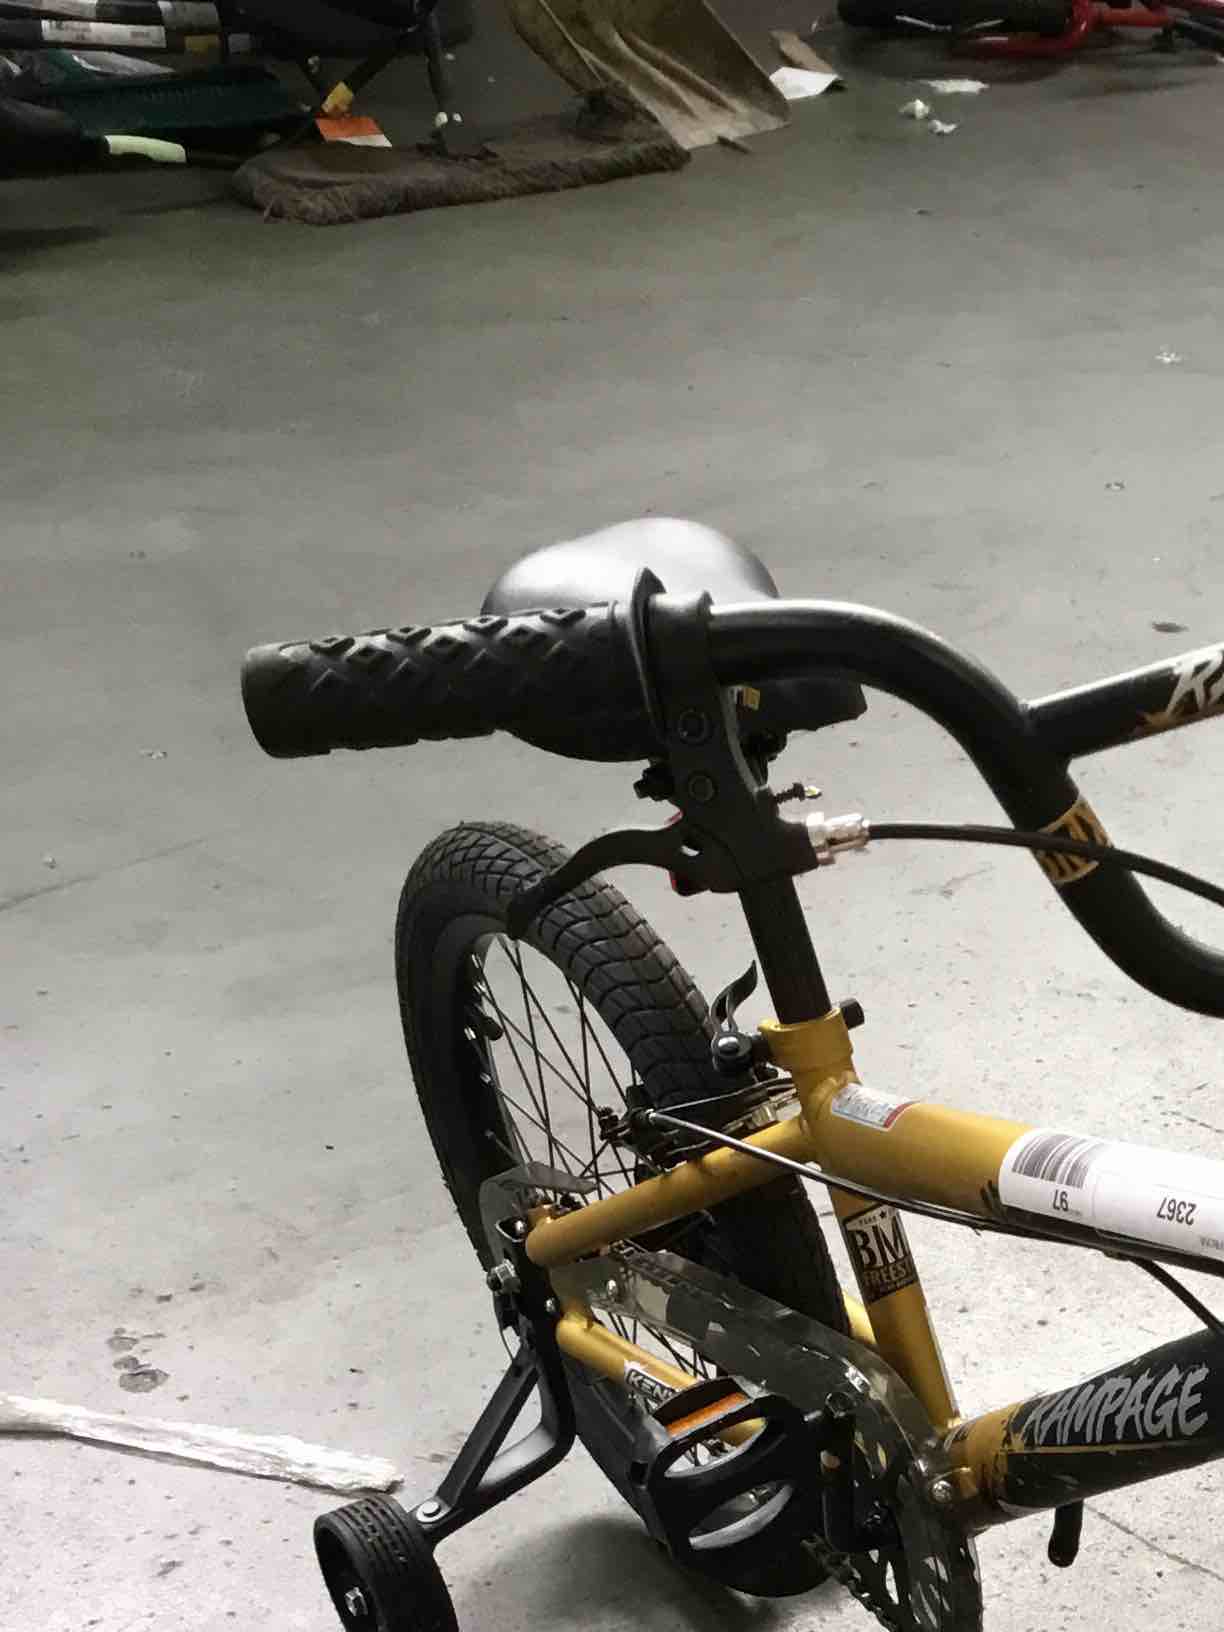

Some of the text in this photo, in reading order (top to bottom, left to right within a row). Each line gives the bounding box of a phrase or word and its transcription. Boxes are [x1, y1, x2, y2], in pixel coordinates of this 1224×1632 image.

[1053, 1189, 1069, 1212] 97
[1157, 1197, 1196, 1226] 2367
[1021, 1364, 1210, 1444] RAMPAGE
